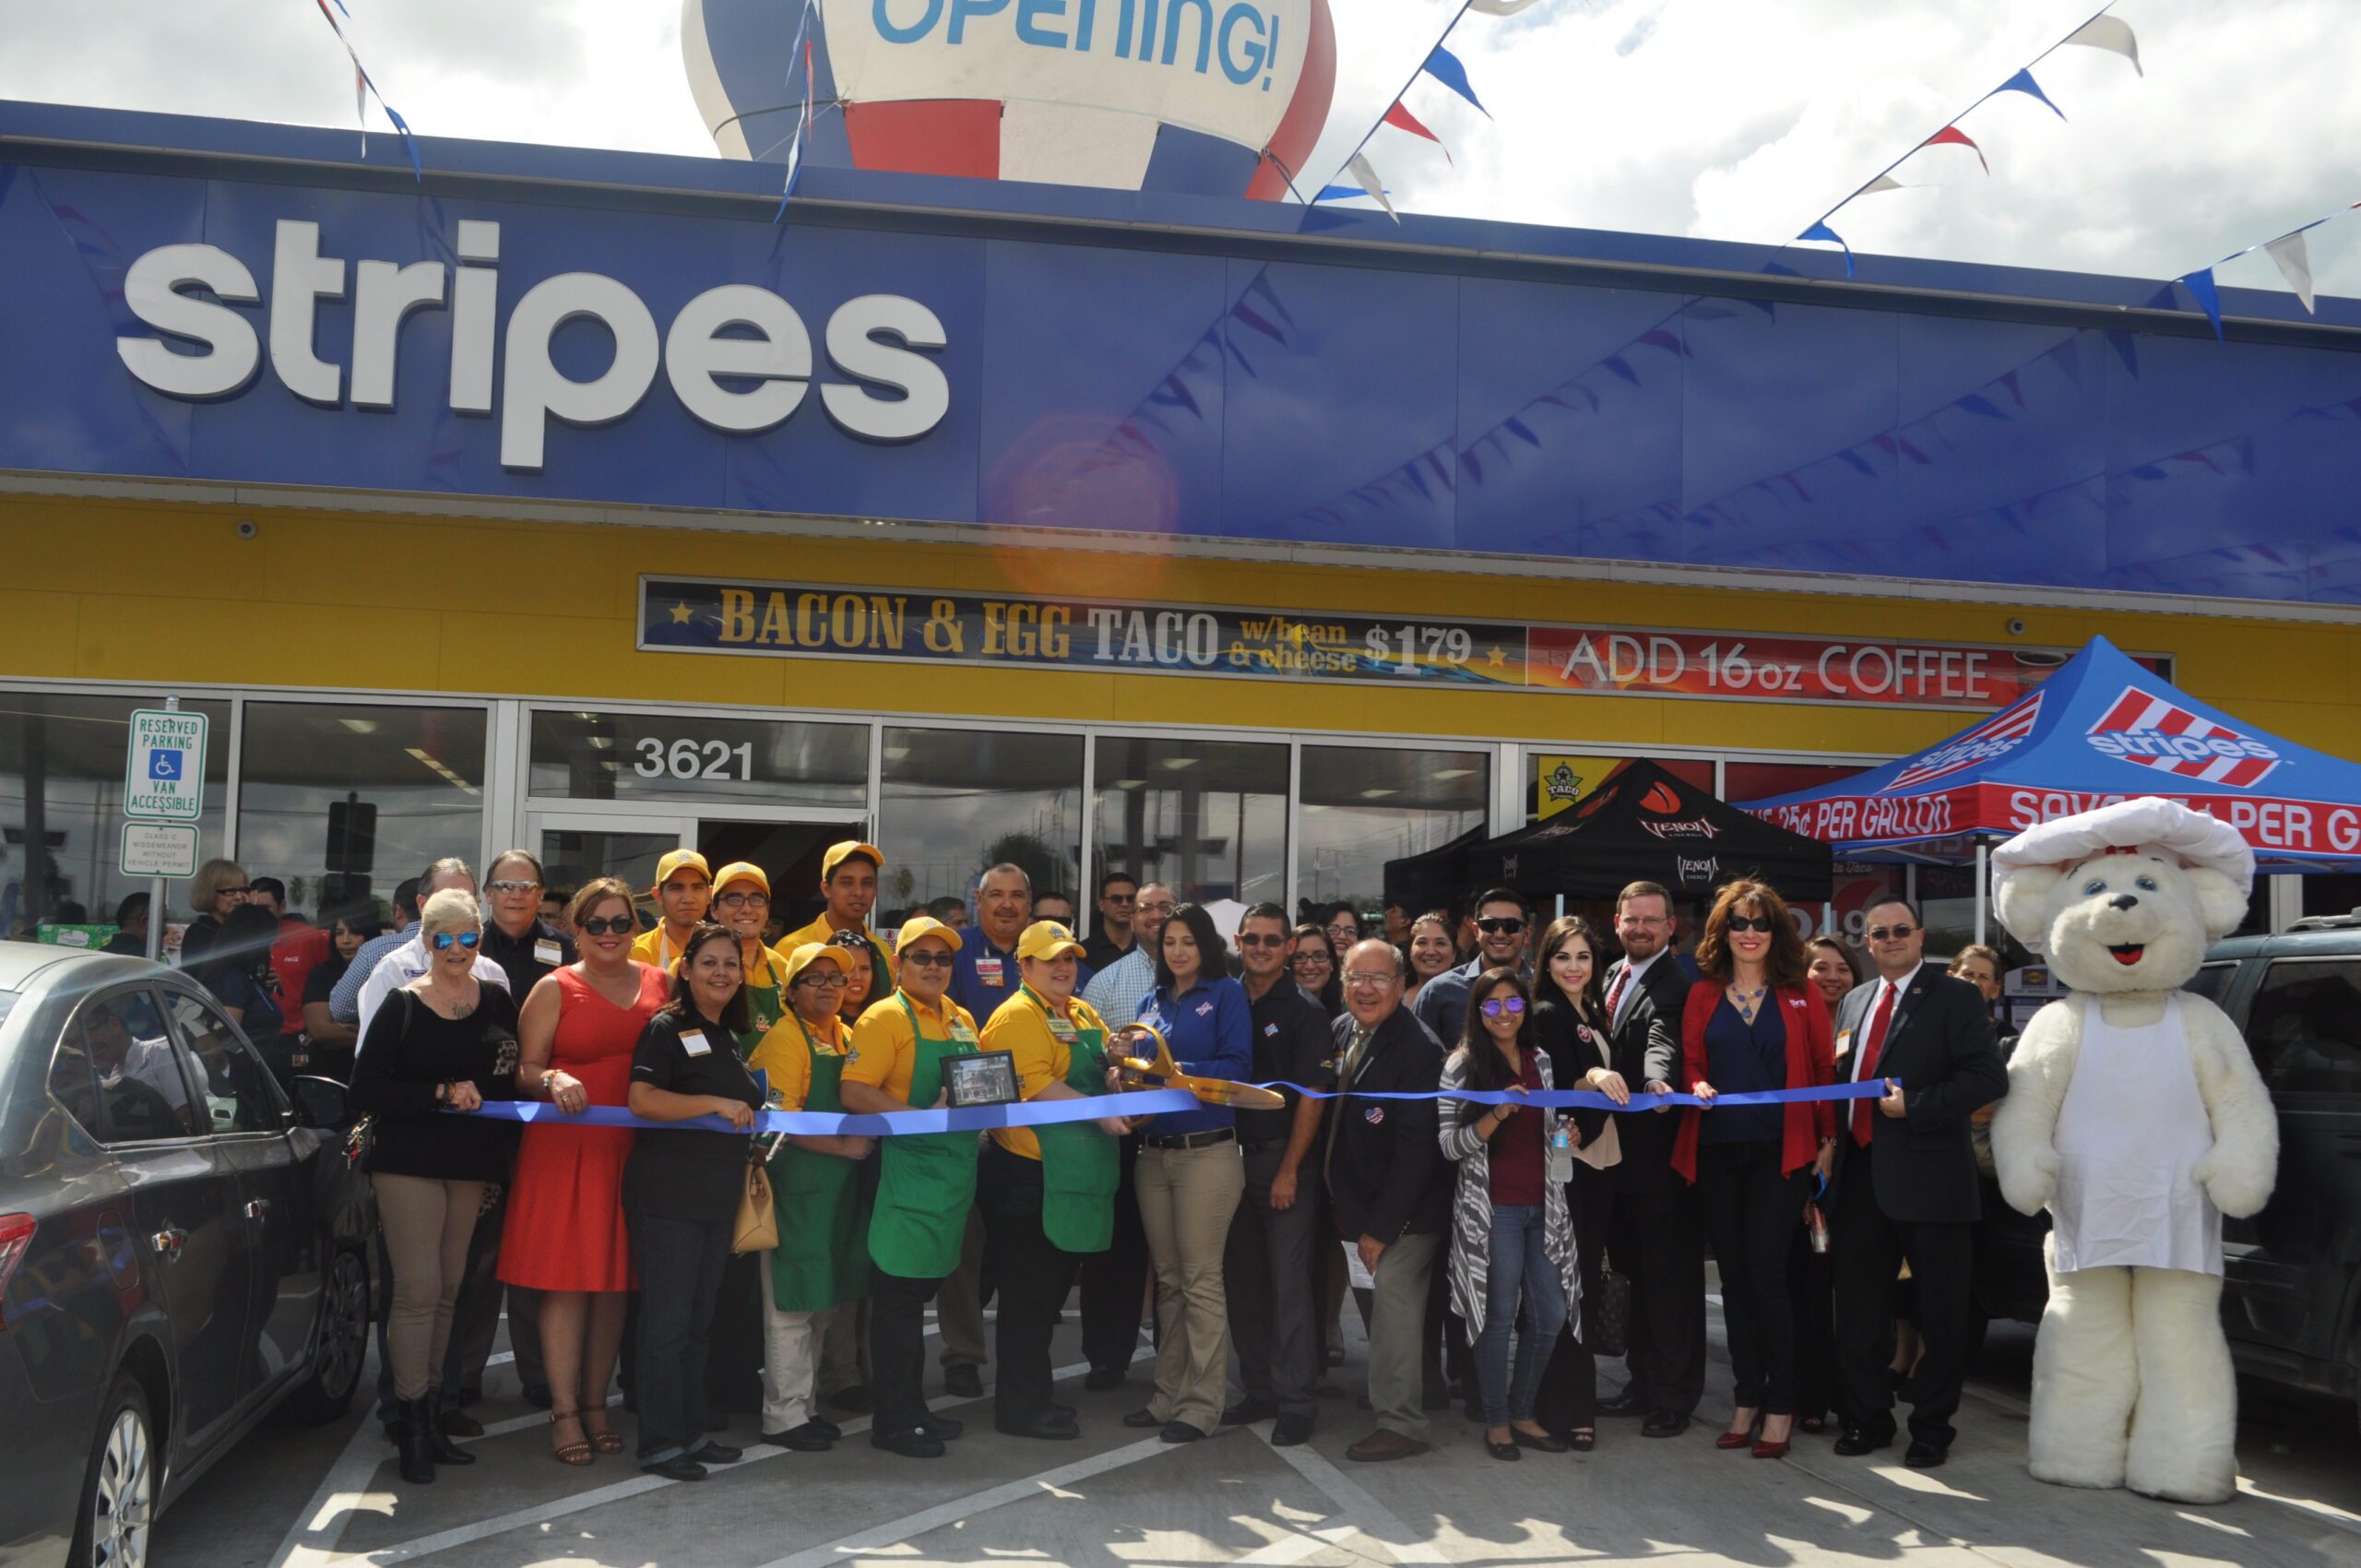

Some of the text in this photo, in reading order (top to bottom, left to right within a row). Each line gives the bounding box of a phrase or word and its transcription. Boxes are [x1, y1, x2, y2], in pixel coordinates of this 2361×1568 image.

[117, 220, 949, 469] stripes
[718, 588, 1218, 665] BACON & EGG TACO
[1240, 616, 1347, 645] w/bean
[1228, 641, 1357, 672] & cheese
[1560, 633, 1686, 684] ADD
[1818, 645, 1991, 699] COFFEE
[140, 719, 197, 735] RESERVED
[142, 734, 193, 750] PARKING
[634, 737, 753, 781] 3621
[2087, 731, 2280, 761] stripes
[153, 780, 176, 794] VAN
[1548, 785, 1579, 796] TACO
[131, 795, 195, 811] ACCESSIBLE
[1815, 801, 1857, 840] PER
[1861, 794, 1951, 837] GALLON
[2010, 790, 2125, 830] SAV
[1638, 817, 1720, 840] VENOM
[2231, 801, 2312, 848] PER
[133, 840, 188, 849] MISDEMEANOR
[127, 859, 159, 867] VEHICLE
[1678, 854, 1719, 884] VENOM
